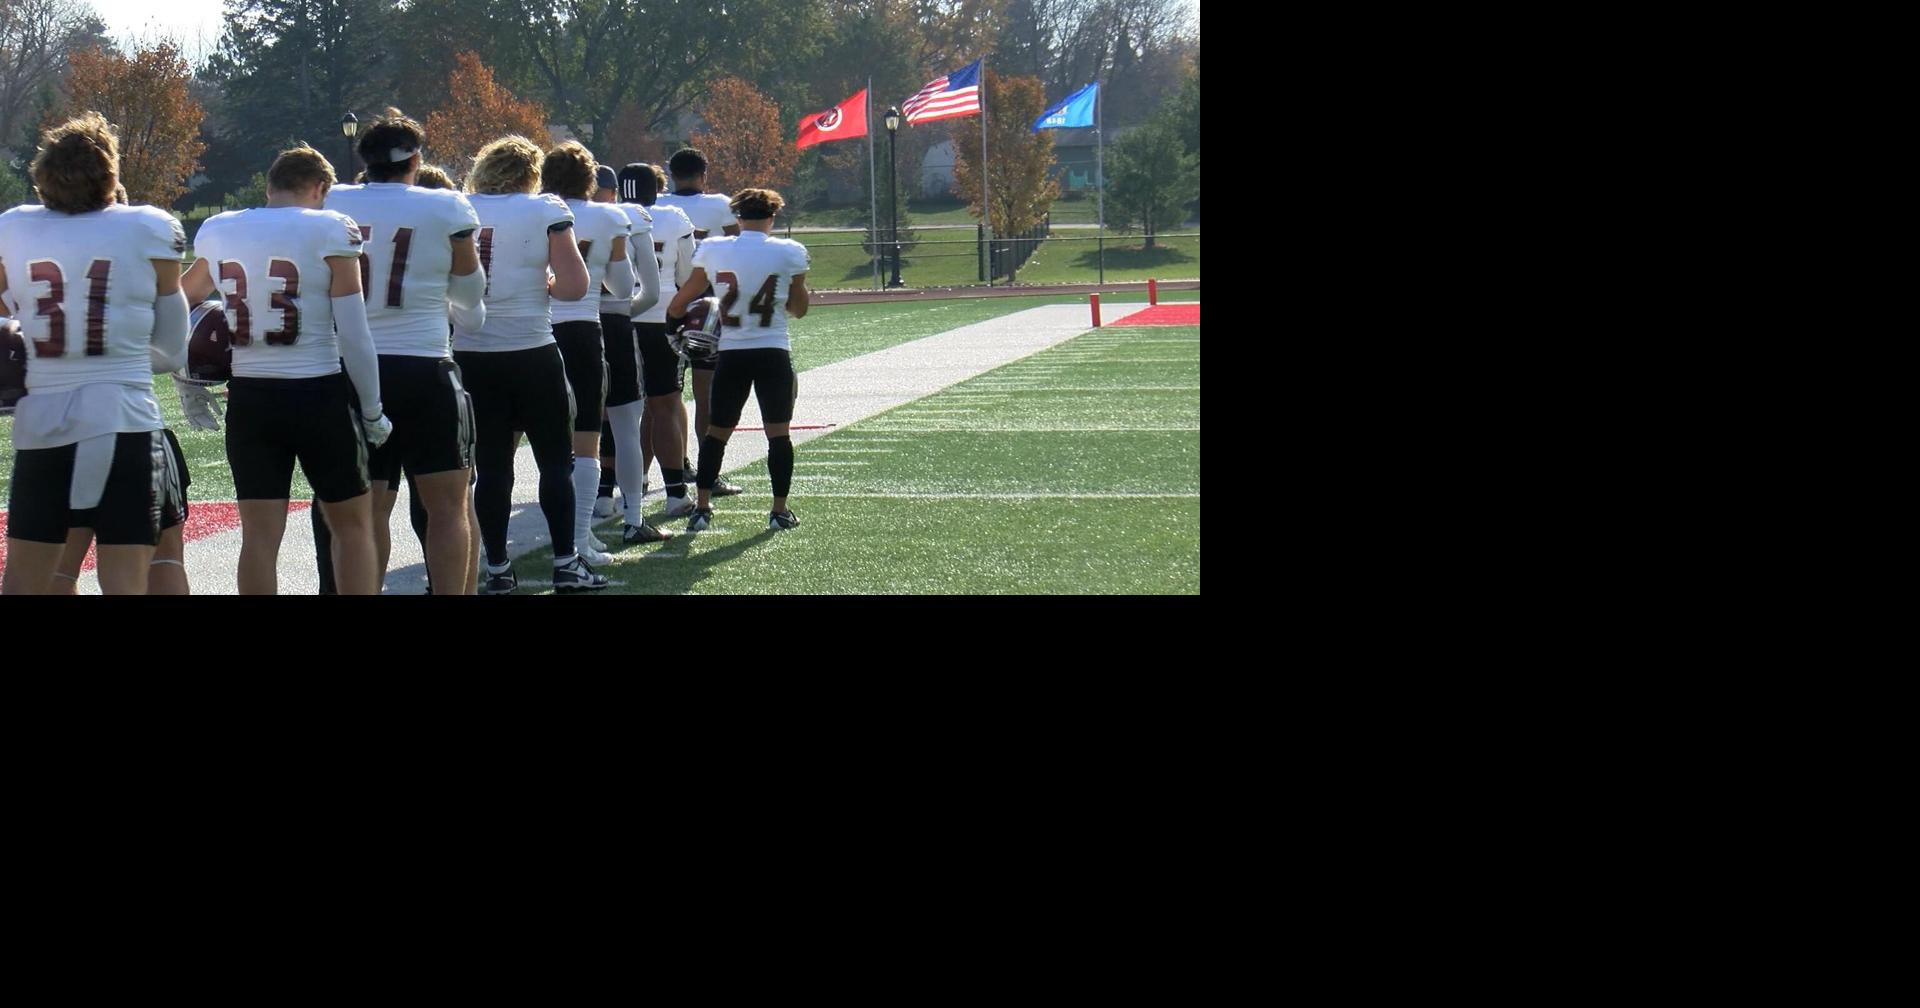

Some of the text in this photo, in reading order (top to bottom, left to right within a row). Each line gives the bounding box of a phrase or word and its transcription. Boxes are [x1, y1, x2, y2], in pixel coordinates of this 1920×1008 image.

[28, 257, 112, 358] 31
[218, 256, 301, 346] 33
[714, 270, 779, 328] 24
